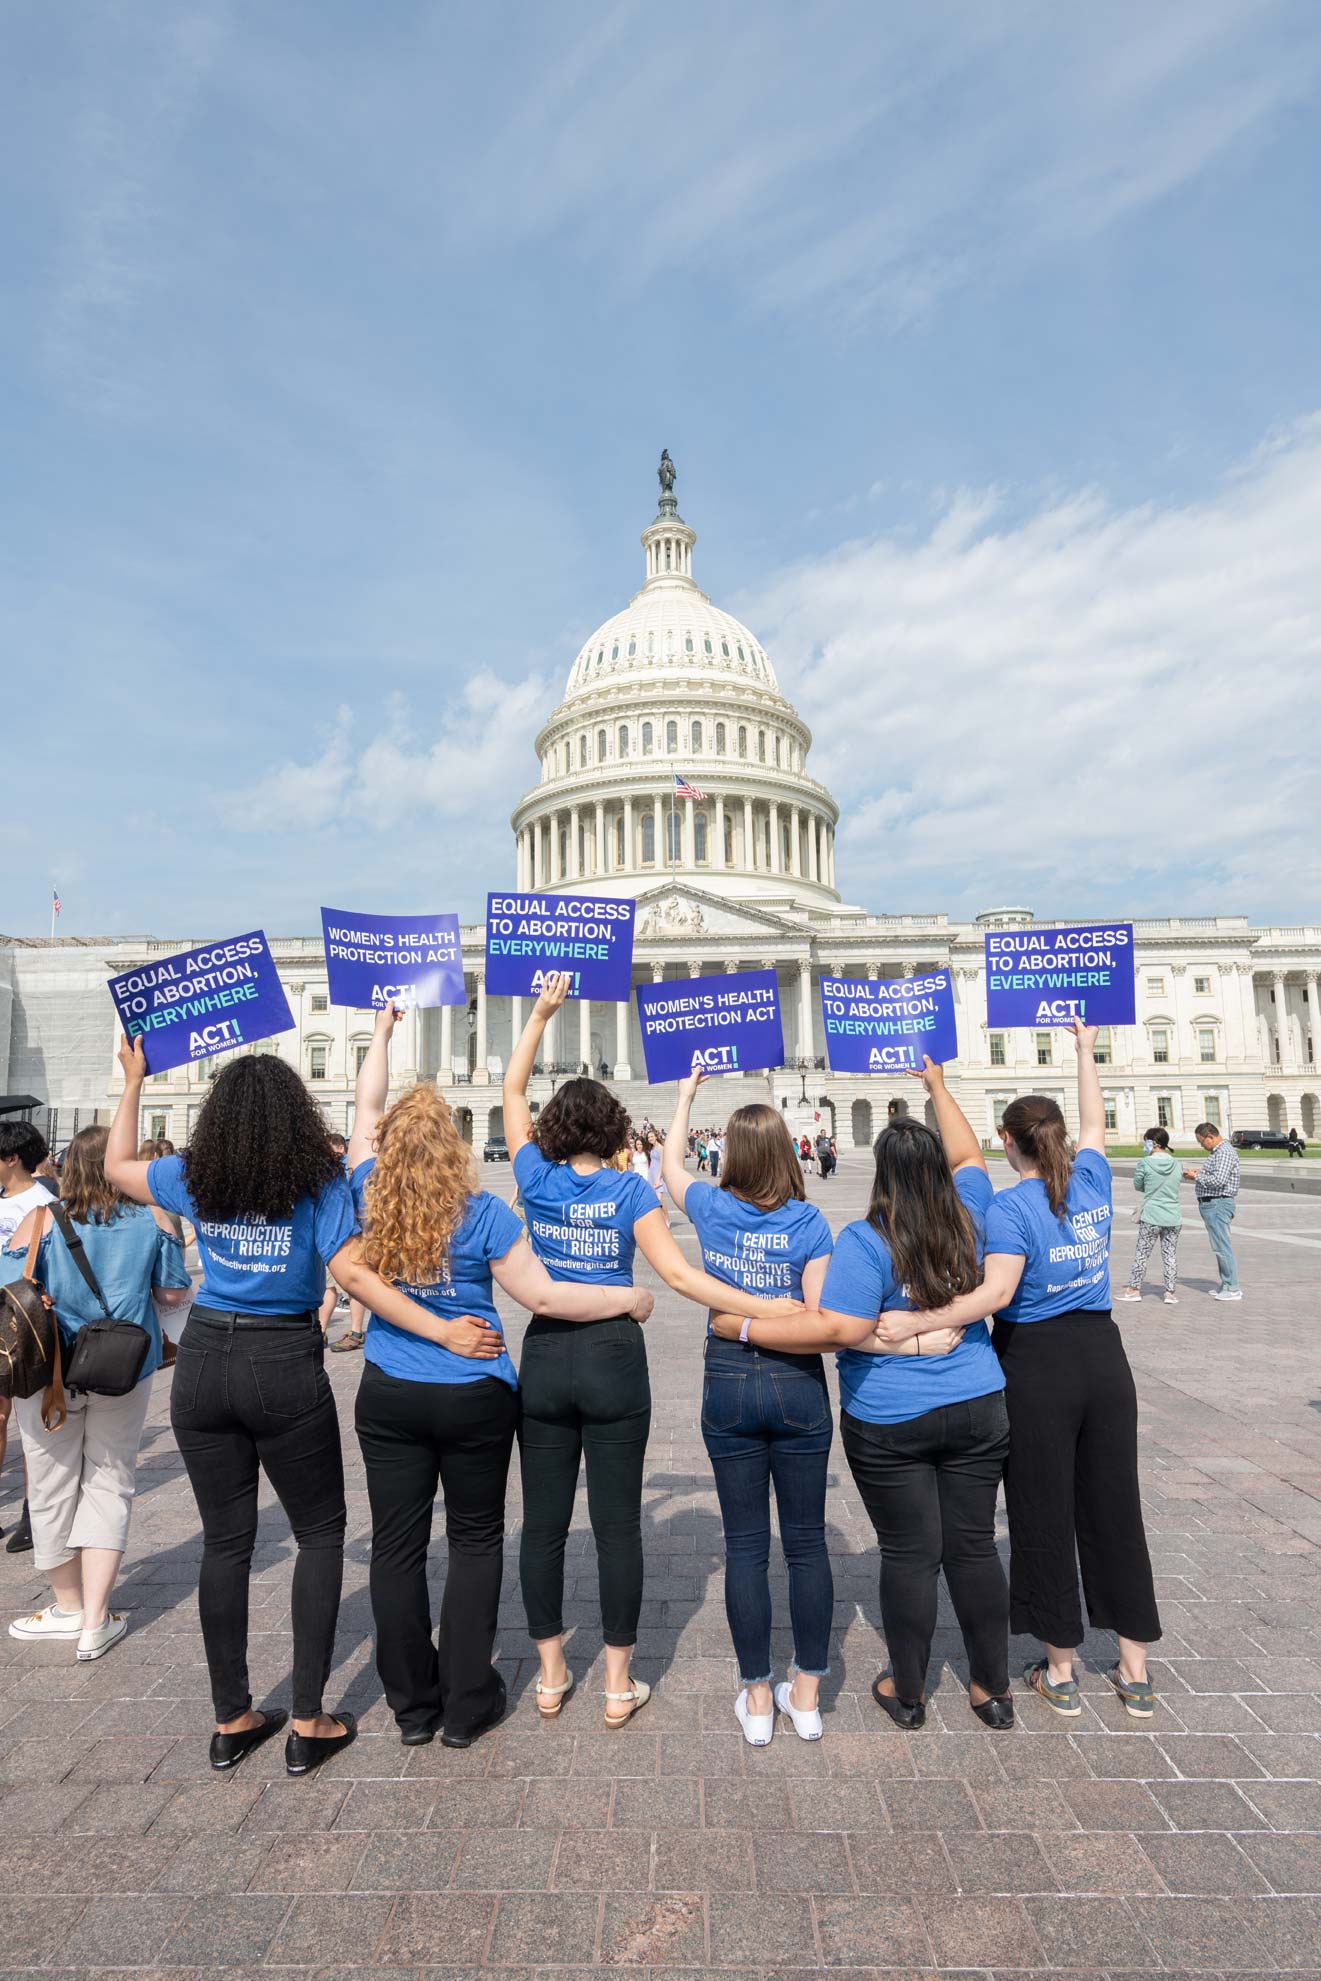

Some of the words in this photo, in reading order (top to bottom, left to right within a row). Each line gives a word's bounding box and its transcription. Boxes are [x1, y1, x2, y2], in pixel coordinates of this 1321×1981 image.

[491, 898, 550, 916] EQUAL
[555, 901, 631, 920] ACCESS
[328, 927, 394, 947] WOMEN'S
[398, 932, 455, 947] HEALTH
[489, 919, 513, 934] TO
[517, 919, 616, 943] ABORTION,
[990, 936, 1050, 952] EQUAL
[1054, 930, 1128, 949] ACCESS
[330, 944, 422, 965] PROTECTION
[426, 948, 457, 963] ACT
[489, 939, 609, 960] EVERYWHERE
[114, 964, 182, 1000] EQUAL
[186, 938, 264, 974] ACCESS
[988, 956, 1013, 971] TO
[1018, 951, 1116, 970] ABORTION,
[120, 996, 148, 1018] TO
[153, 962, 258, 1007] ABORTION,
[823, 982, 874, 999] EQUAL
[878, 975, 947, 999] ACCESS
[990, 971, 1111, 990] EVERYWHERE
[127, 982, 258, 1037] EVERYWHERE
[644, 995, 714, 1016] WOMEN'S
[718, 988, 774, 1006] HEALTH
[824, 1000, 845, 1016] TO
[849, 997, 939, 1018] ABORTION,
[1036, 1000, 1086, 1022] ACT!
[646, 1010, 742, 1035] PROTECTION
[746, 1006, 776, 1022] ACT
[826, 1016, 936, 1036] EVERYWHERE
[188, 1018, 244, 1051] ACT!
[190, 1048, 207, 1058] FOR
[208, 1038, 237, 1052] WOMEN
[690, 1046, 738, 1068] ACT!
[868, 1046, 916, 1068] ACT!
[706, 1063, 732, 1072] WOMEN
[884, 1062, 910, 1070] WOMEN
[570, 1202, 616, 1218] CENTER
[1072, 1204, 1110, 1230] CENTER
[200, 1222, 293, 1241] REPRODUCTIVE
[532, 1220, 619, 1242] REPRODUCTIVE
[570, 1218, 594, 1228] FOR
[743, 1232, 788, 1249] CENTER
[1076, 1226, 1100, 1243] FOR
[239, 1241, 291, 1256] RIGHTS
[571, 1241, 619, 1256] RIGHTS
[742, 1246, 766, 1262] FOR
[704, 1248, 790, 1275] REPRODUCTIVE
[743, 1272, 792, 1288] RIGHTS
